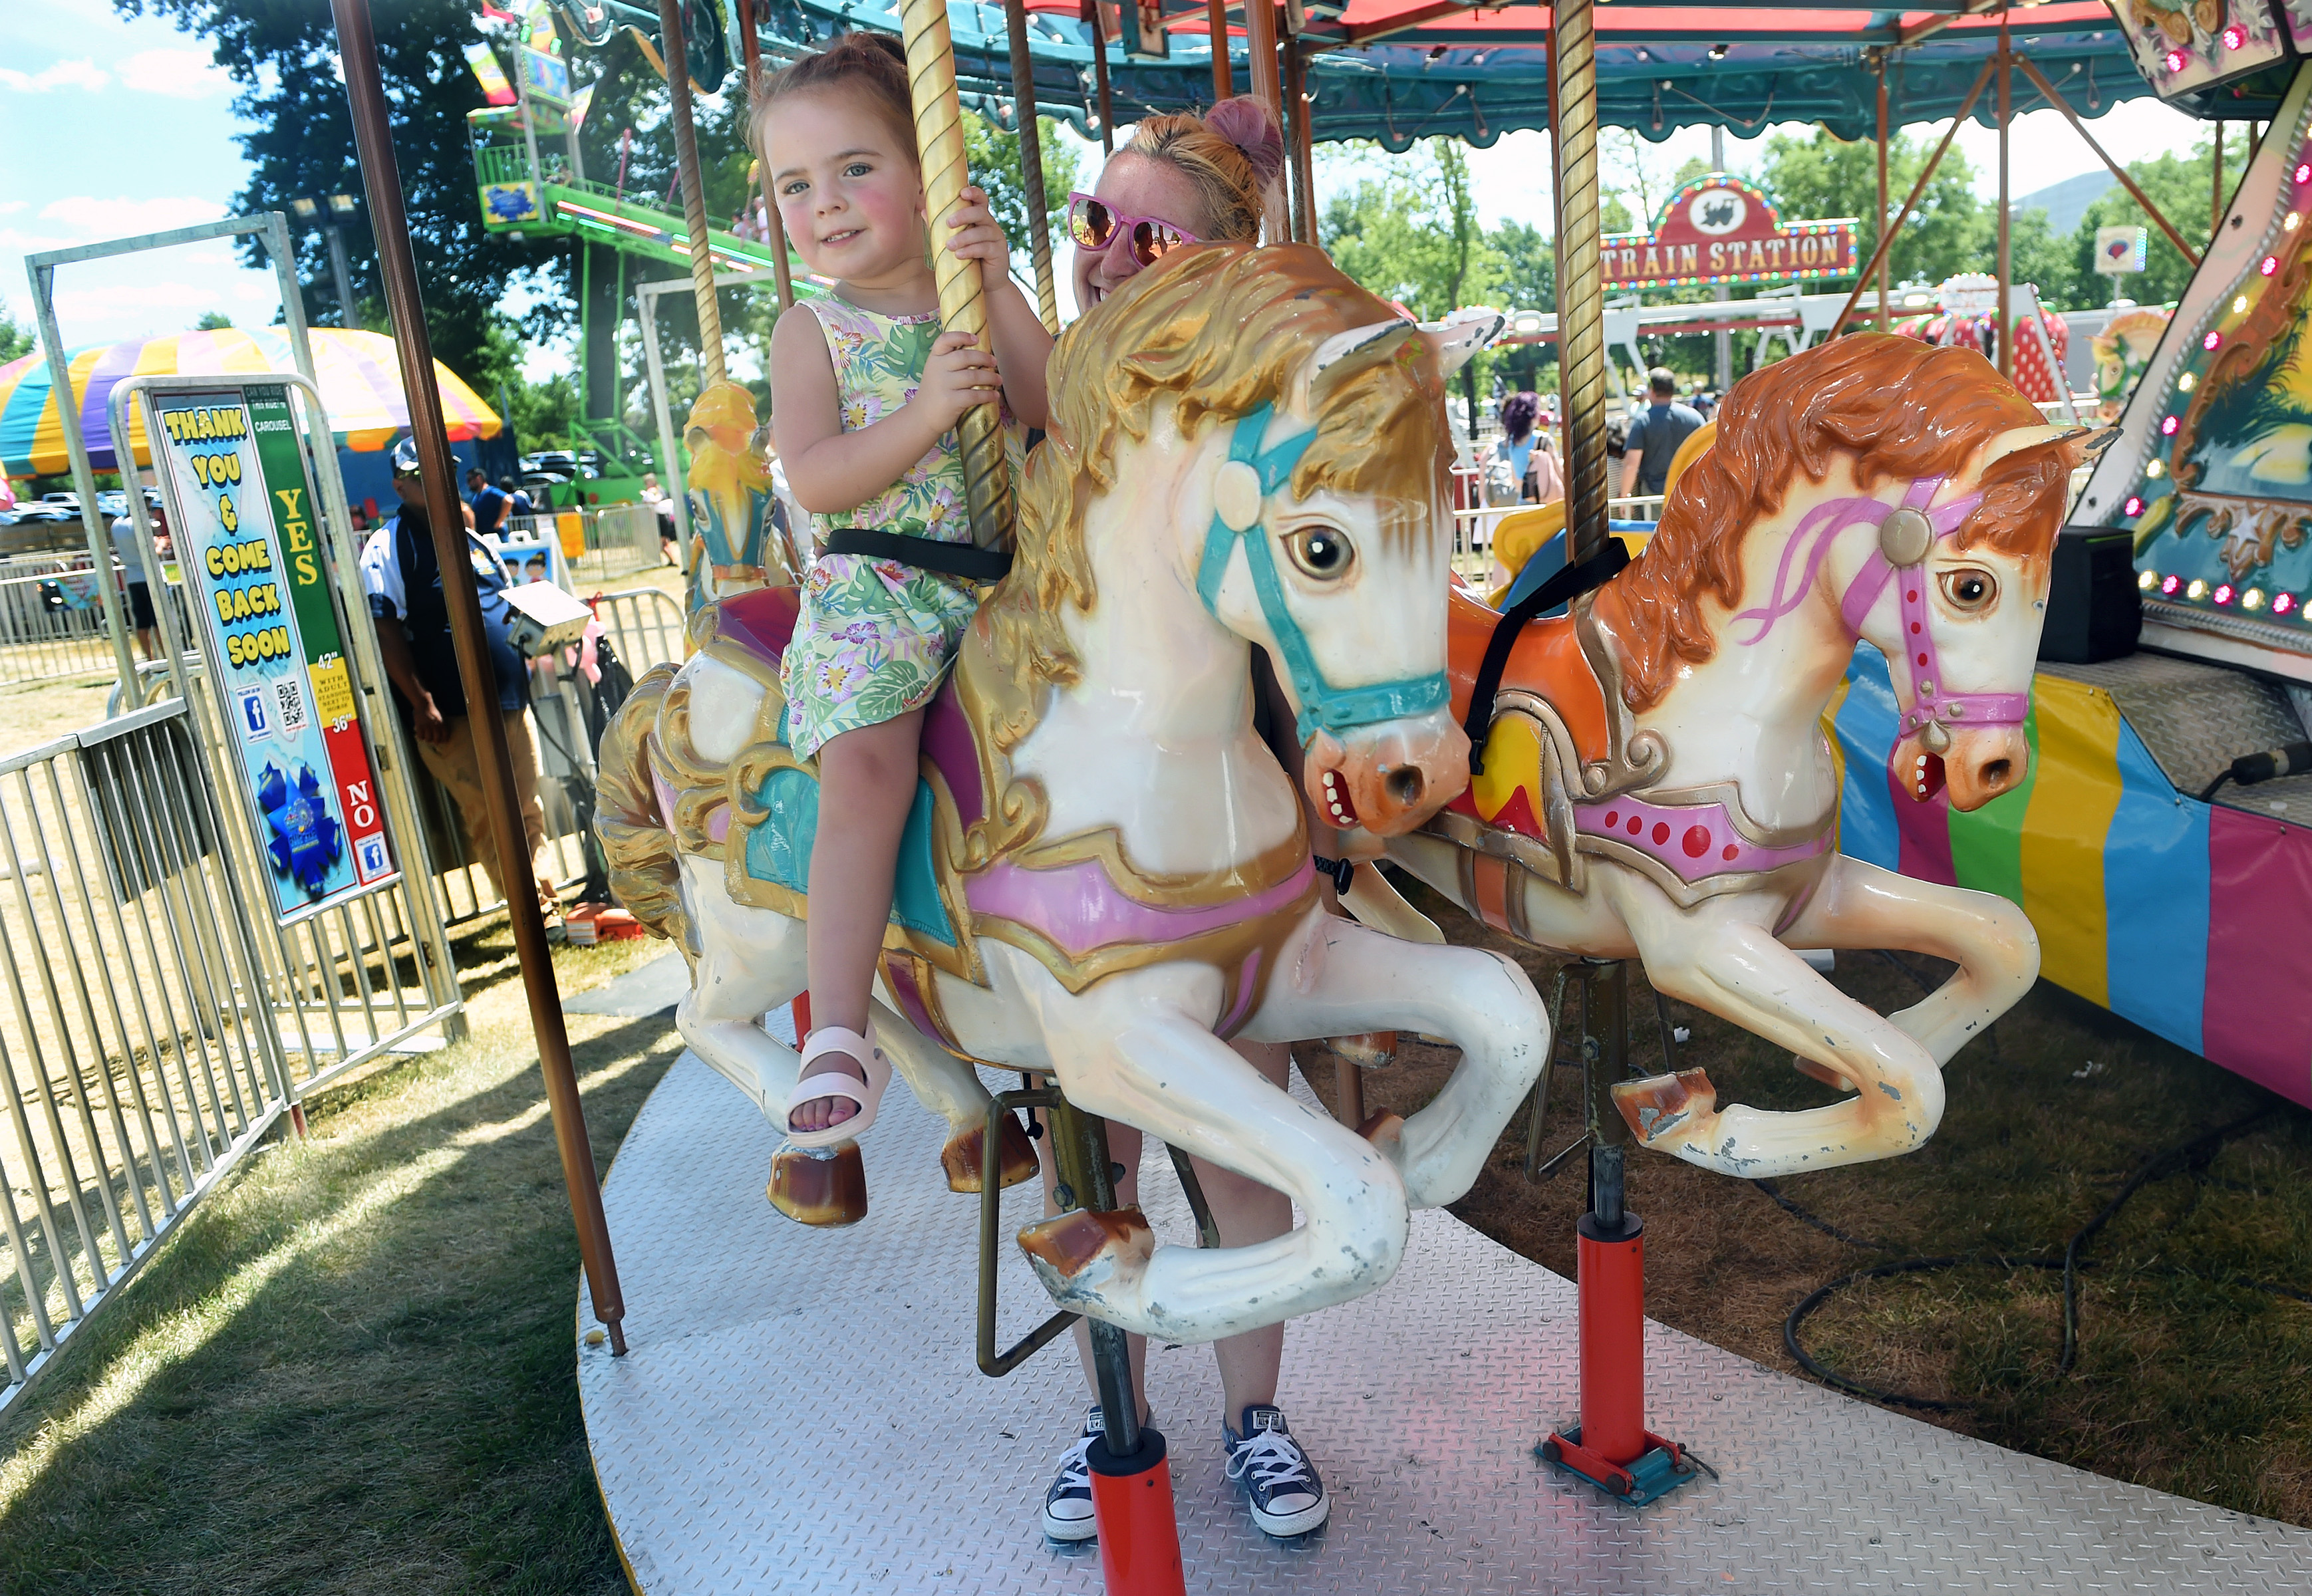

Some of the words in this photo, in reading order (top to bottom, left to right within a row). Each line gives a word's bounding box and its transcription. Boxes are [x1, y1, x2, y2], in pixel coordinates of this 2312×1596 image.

[1600, 243, 1698, 279] TRAIN
[1709, 235, 1839, 271] STATION
[163, 408, 247, 446] THANK
[255, 420, 292, 432] CAROUSEL
[191, 452, 241, 490] YOU
[219, 493, 238, 536] &
[275, 488, 318, 586] YES
[205, 539, 271, 580] COME
[214, 583, 281, 626] BACK
[226, 626, 291, 669] SOON
[318, 651, 338, 670] 42"
[318, 681, 347, 693] ADULT
[319, 674, 343, 685] WITH
[332, 713, 352, 733] 36"
[347, 780, 374, 828] NO
